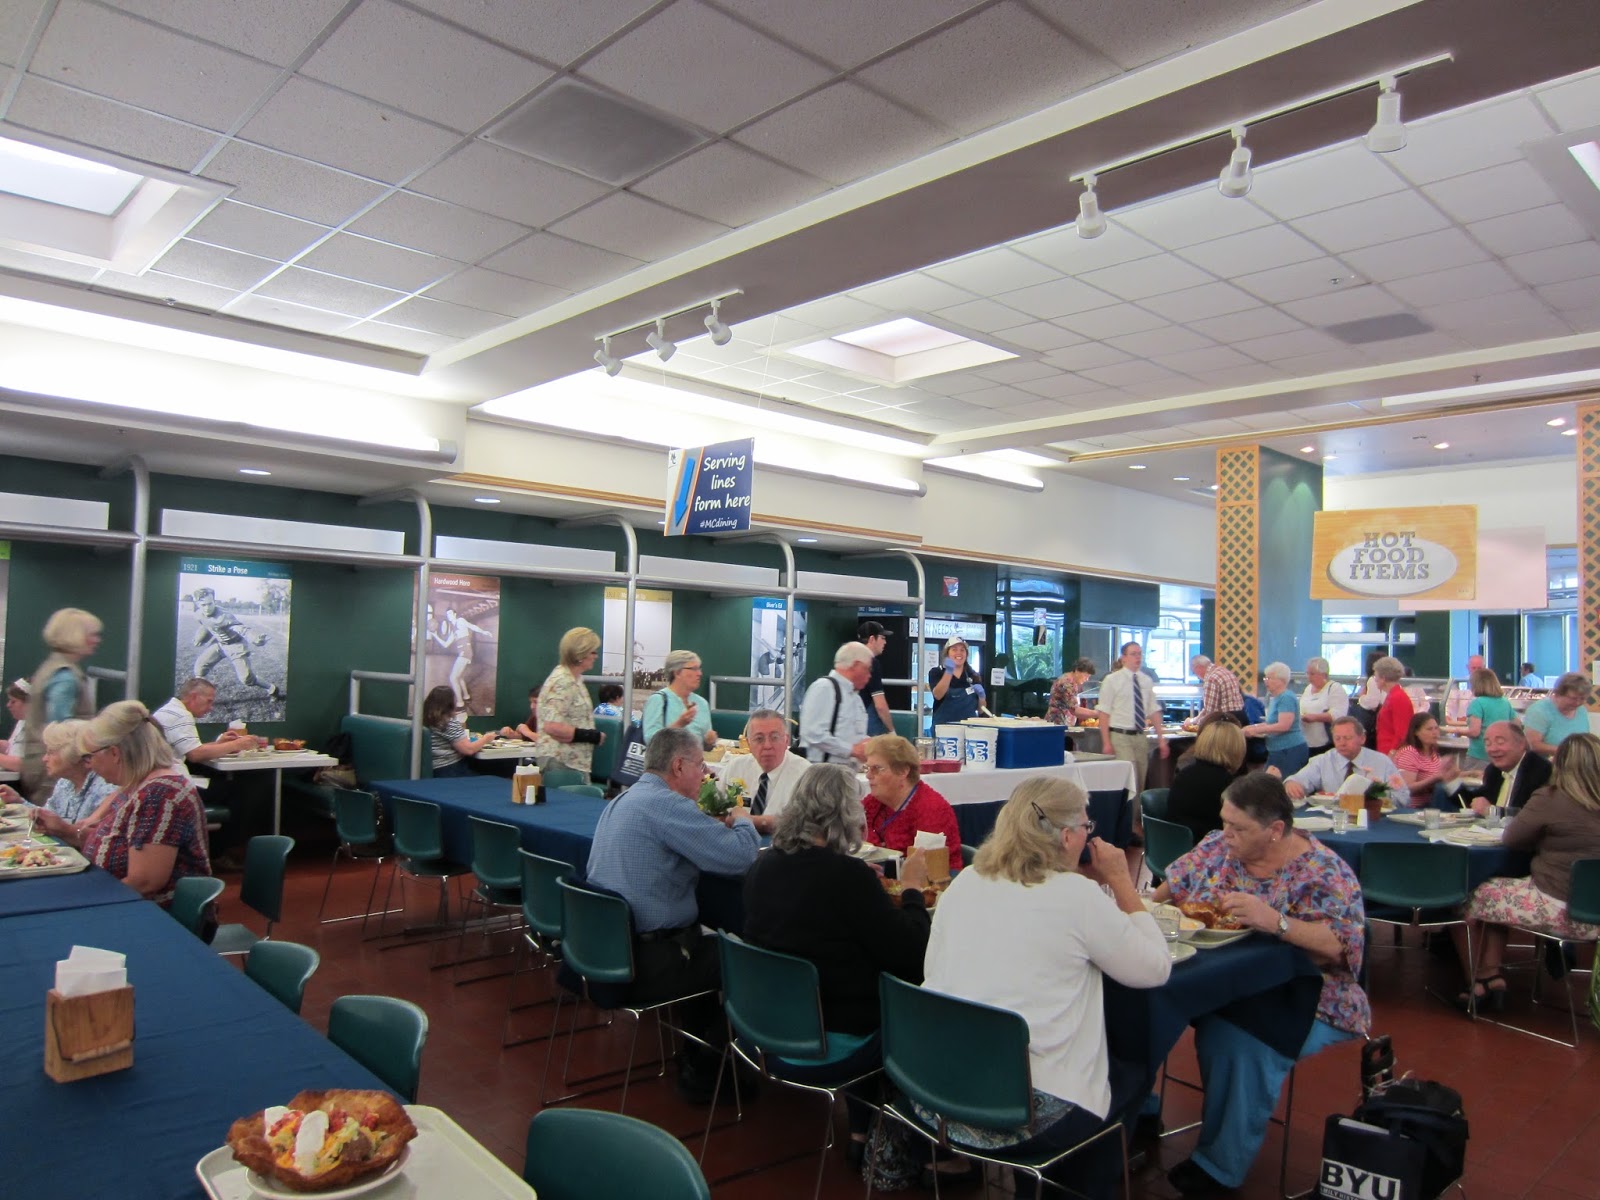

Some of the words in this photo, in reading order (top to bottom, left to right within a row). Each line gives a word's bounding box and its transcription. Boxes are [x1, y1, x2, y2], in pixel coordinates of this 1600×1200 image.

[703, 452, 746, 471] Serving
[711, 474, 736, 490] lines
[694, 495, 721, 512] form
[725, 493, 751, 509] here
[699, 517, 738, 529] #MCdining
[1363, 531, 1416, 548] HOT
[1352, 547, 1425, 564] FOOD
[183, 563, 198, 572] 1921
[207, 564, 226, 573] Strike
[233, 566, 248, 575] Pose
[1349, 563, 1430, 580] ITEMS
[933, 623, 953, 635] NEEDS
[630, 744, 646, 755] BY
[946, 738, 957, 758] BYU
[975, 741, 987, 762] BYU
[1321, 1160, 1397, 1200] BYU
